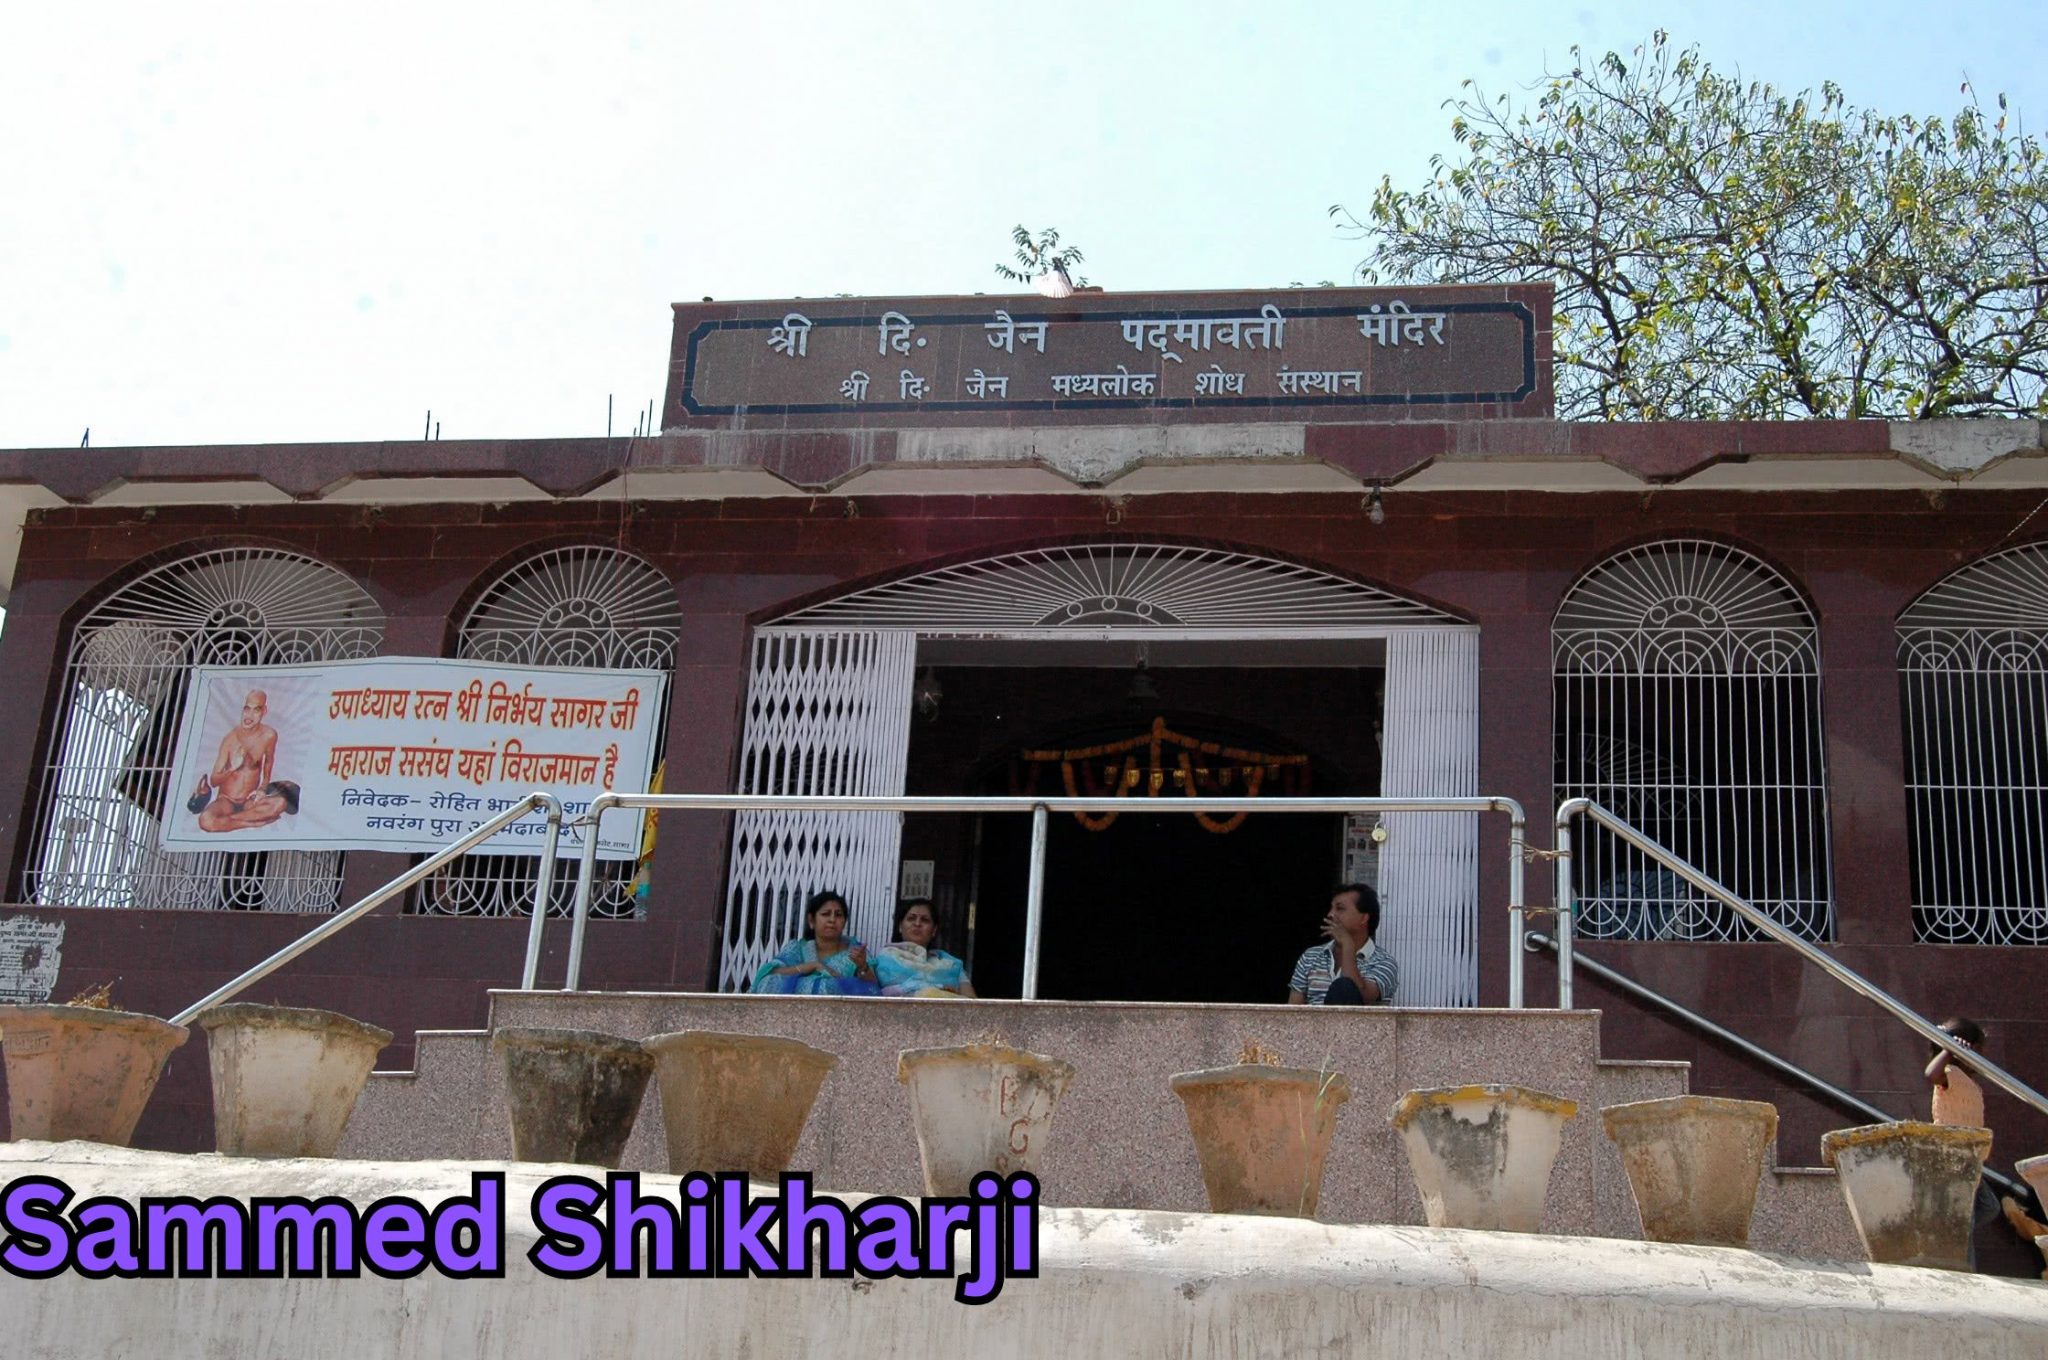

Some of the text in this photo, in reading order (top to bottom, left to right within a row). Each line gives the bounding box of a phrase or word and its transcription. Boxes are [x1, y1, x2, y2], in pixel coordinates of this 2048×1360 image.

[766, 300, 1446, 363] श्री दि. जैन पद्मावती मंदिर
[838, 364, 1363, 400] श्री दि. जैन मध्यलोक शोध संस्थान
[328, 679, 639, 731] उपाध्याय रत्न श्री निर्भय सागर जी
[328, 737, 618, 790] महाराज ससंघ यहां विराजमान है
[429, 791, 482, 812] रोहित
[366, 814, 425, 831] नवरंग
[431, 818, 463, 836] पुरा
